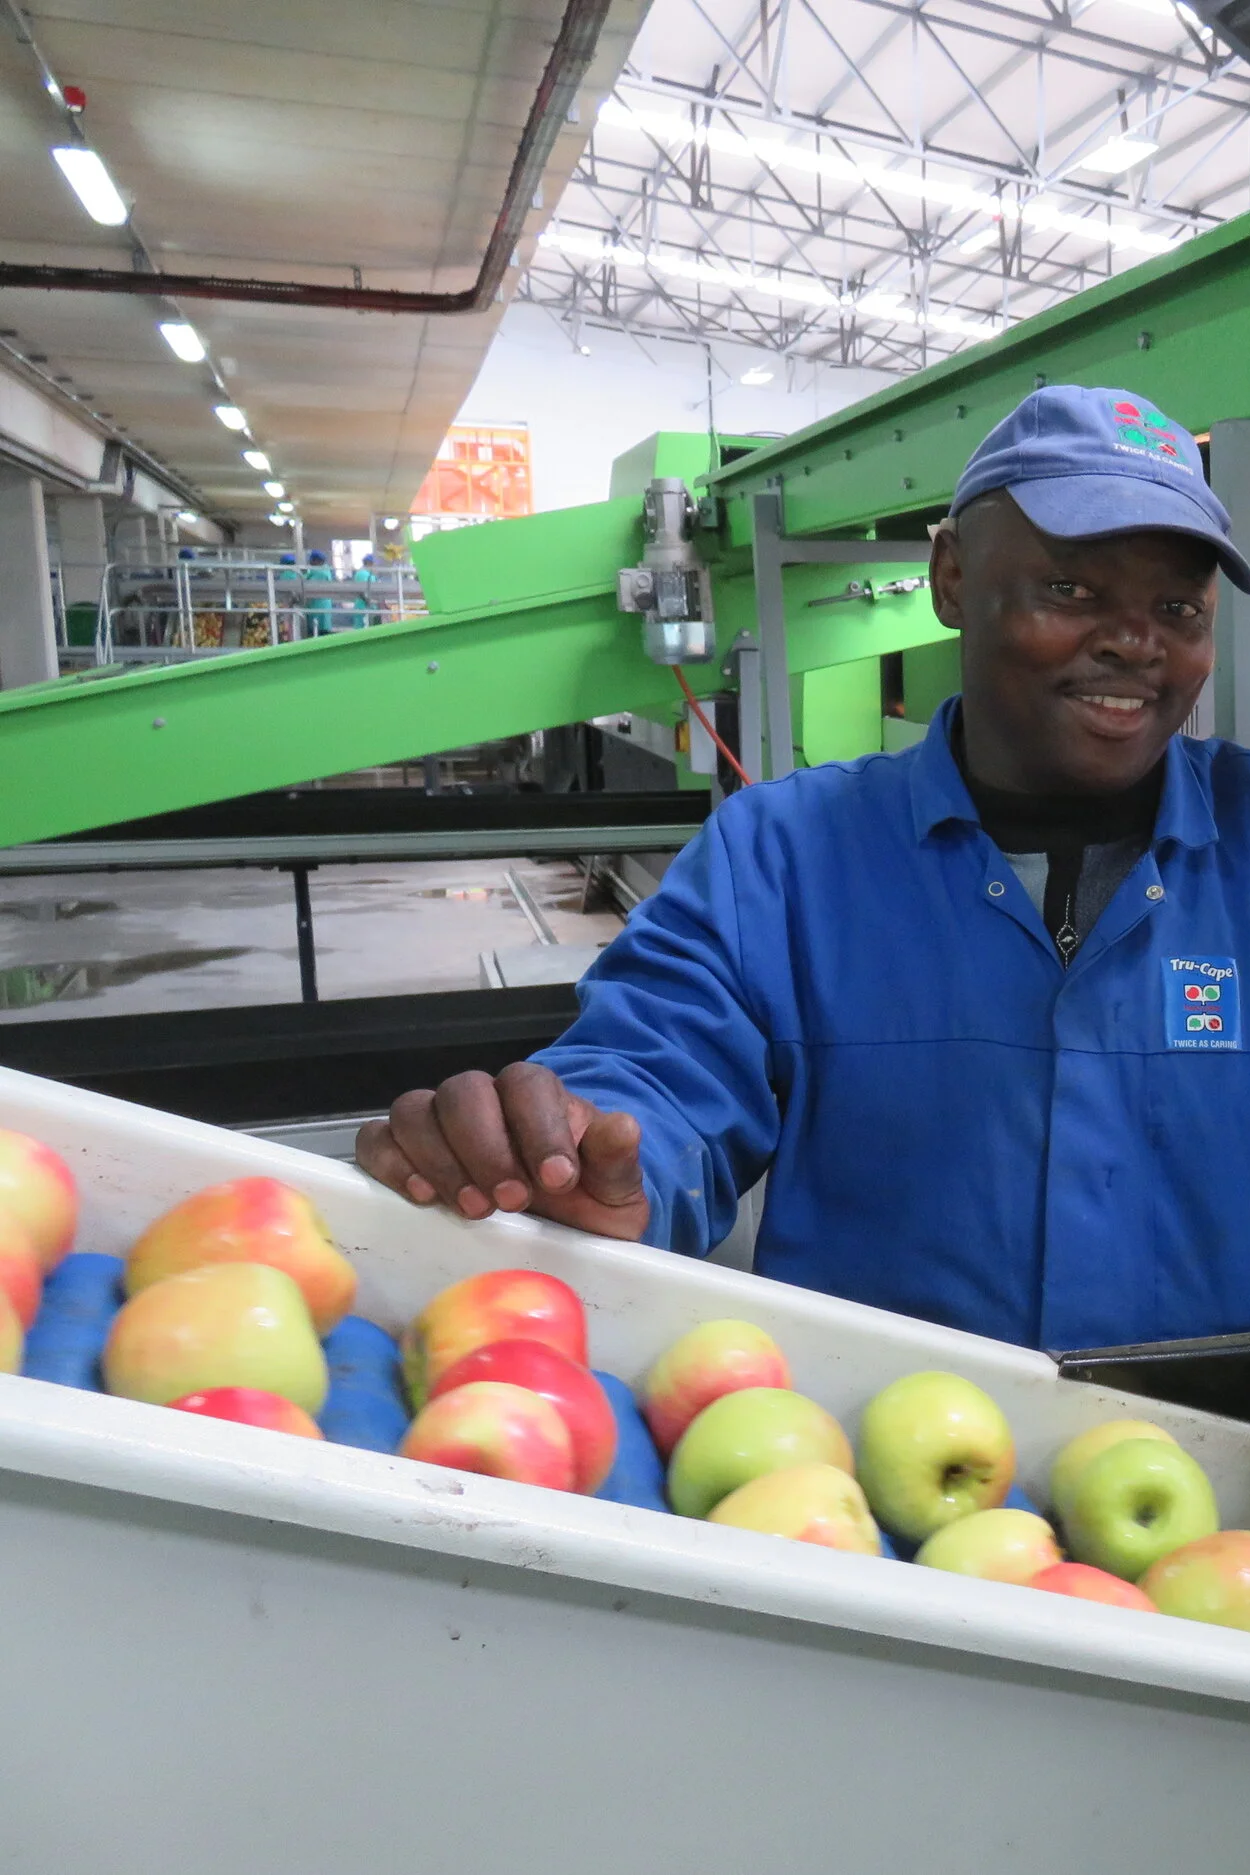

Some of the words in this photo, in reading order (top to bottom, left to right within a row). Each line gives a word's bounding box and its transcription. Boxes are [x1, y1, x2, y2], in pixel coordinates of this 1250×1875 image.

[1113, 443, 1146, 456] TWICE
[1170, 958, 1233, 982] Tru-Cape
[1173, 1039, 1197, 1048] TWICE
[1199, 1039, 1209, 1048] AS
[1210, 1039, 1237, 1049] CARING
